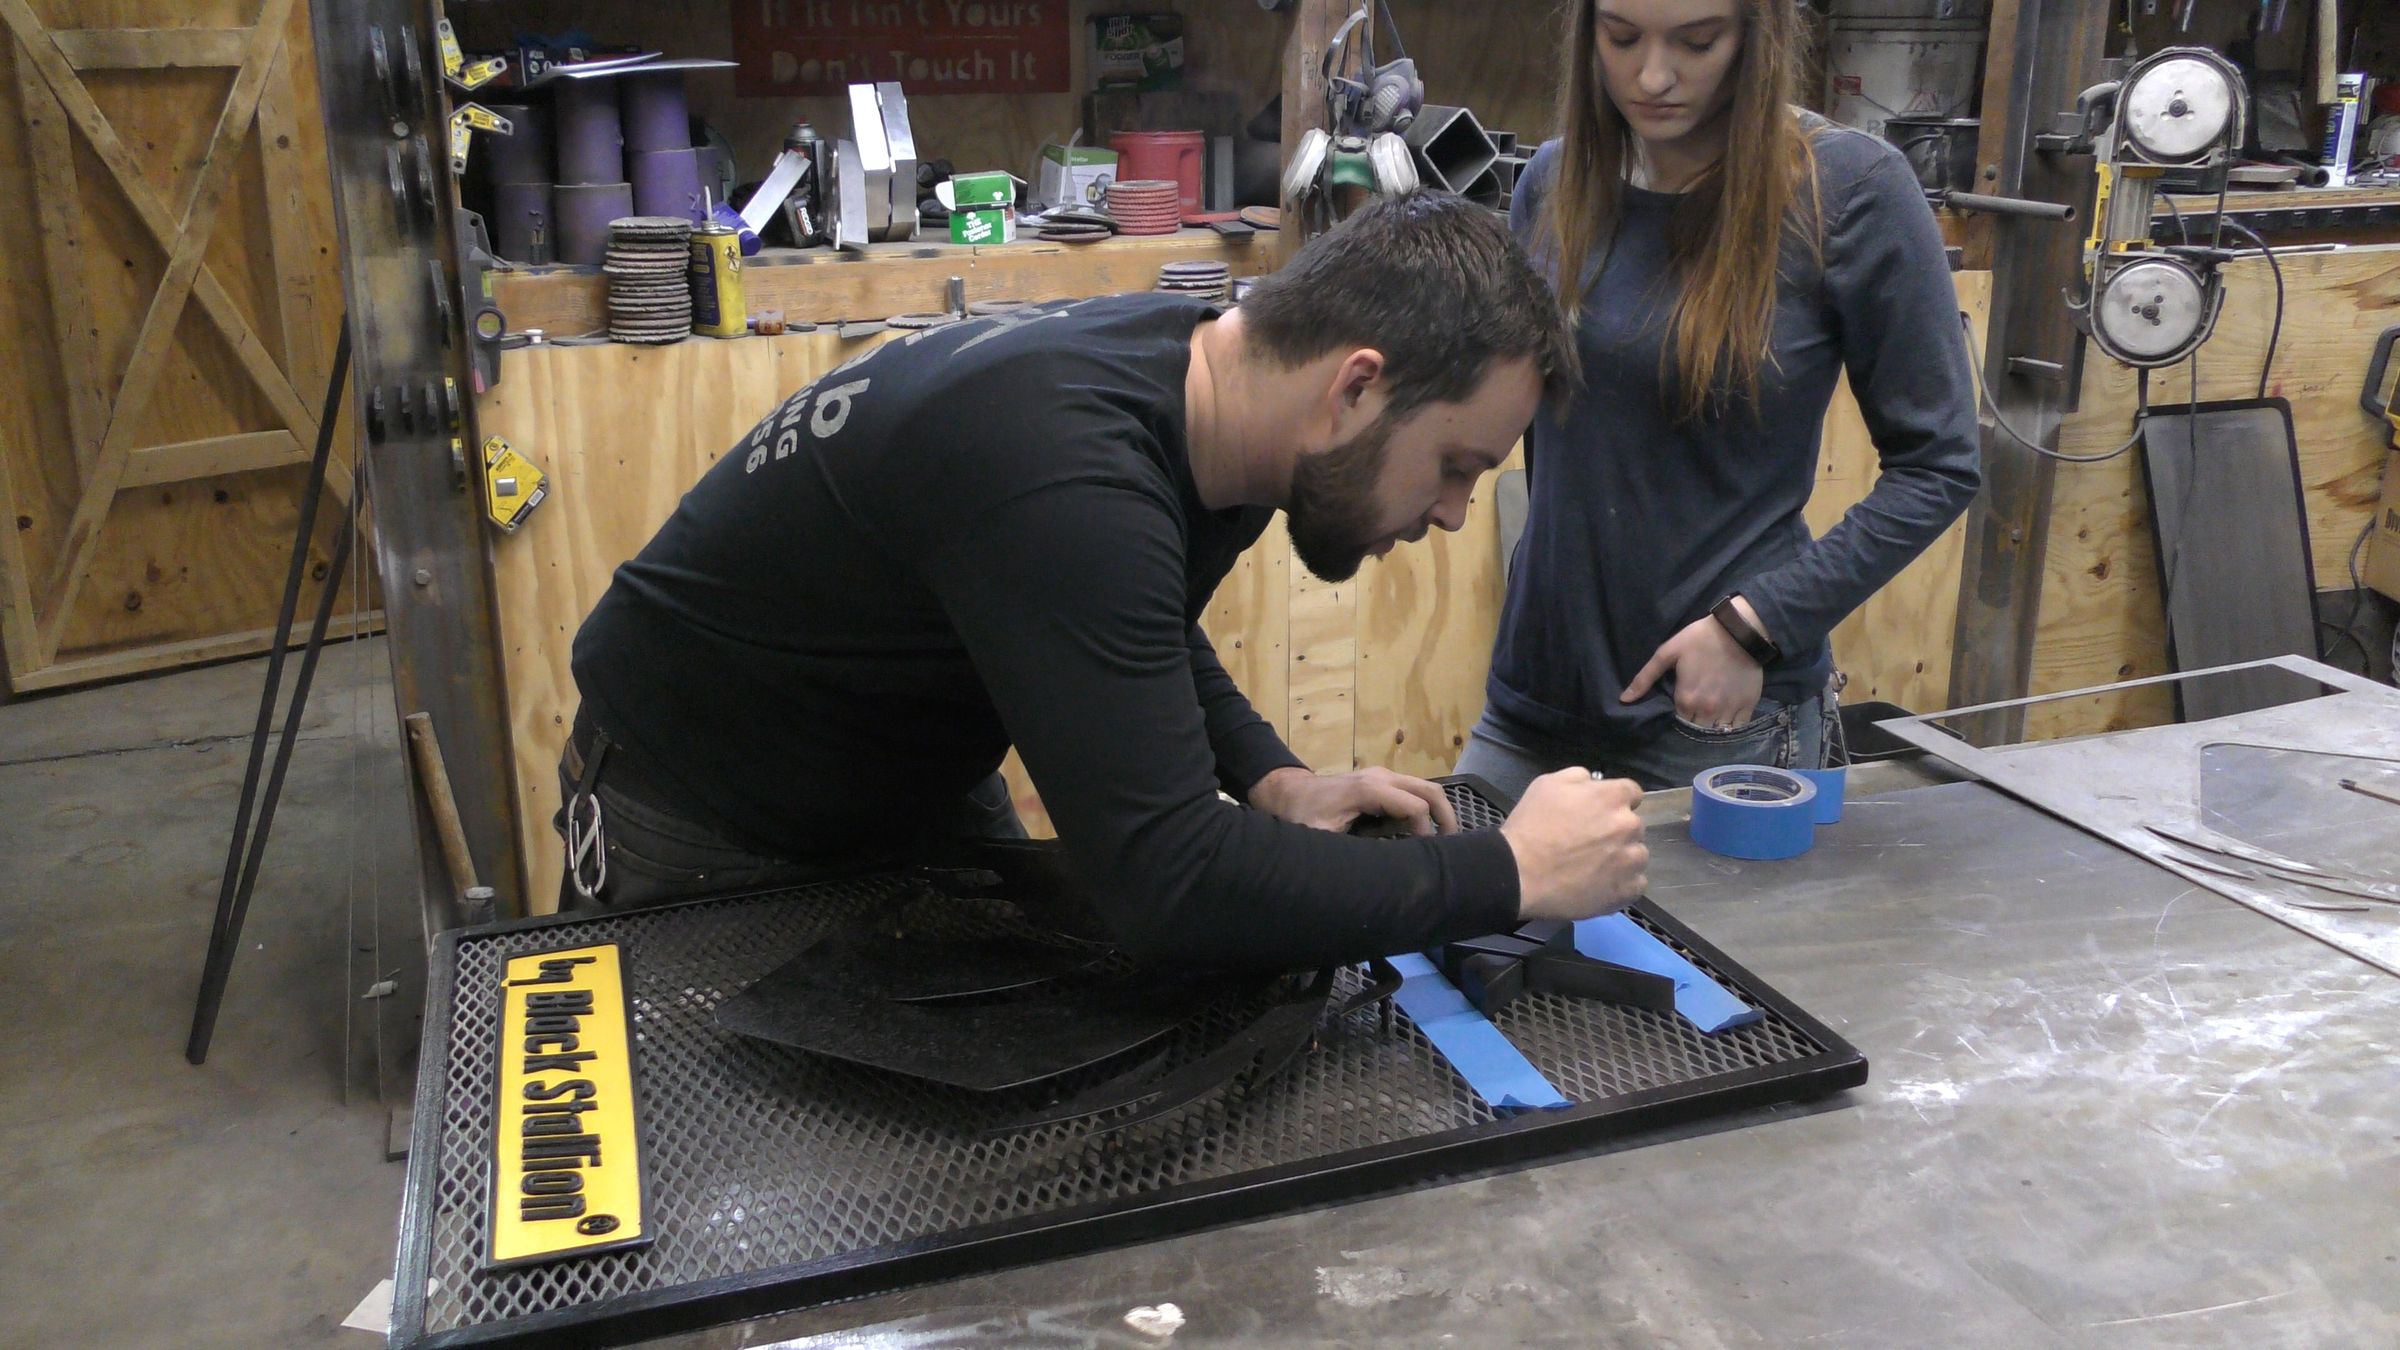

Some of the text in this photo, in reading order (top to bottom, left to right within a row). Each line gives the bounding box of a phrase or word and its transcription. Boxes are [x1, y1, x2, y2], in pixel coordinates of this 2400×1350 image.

[852, 0, 930, 28] Isn't
[949, 0, 1043, 28] Yours
[771, 48, 1036, 84] Don't Touch It
[507, 956, 597, 987] by
[522, 989, 598, 1074] Black
[520, 1079, 603, 1223] Stallion
